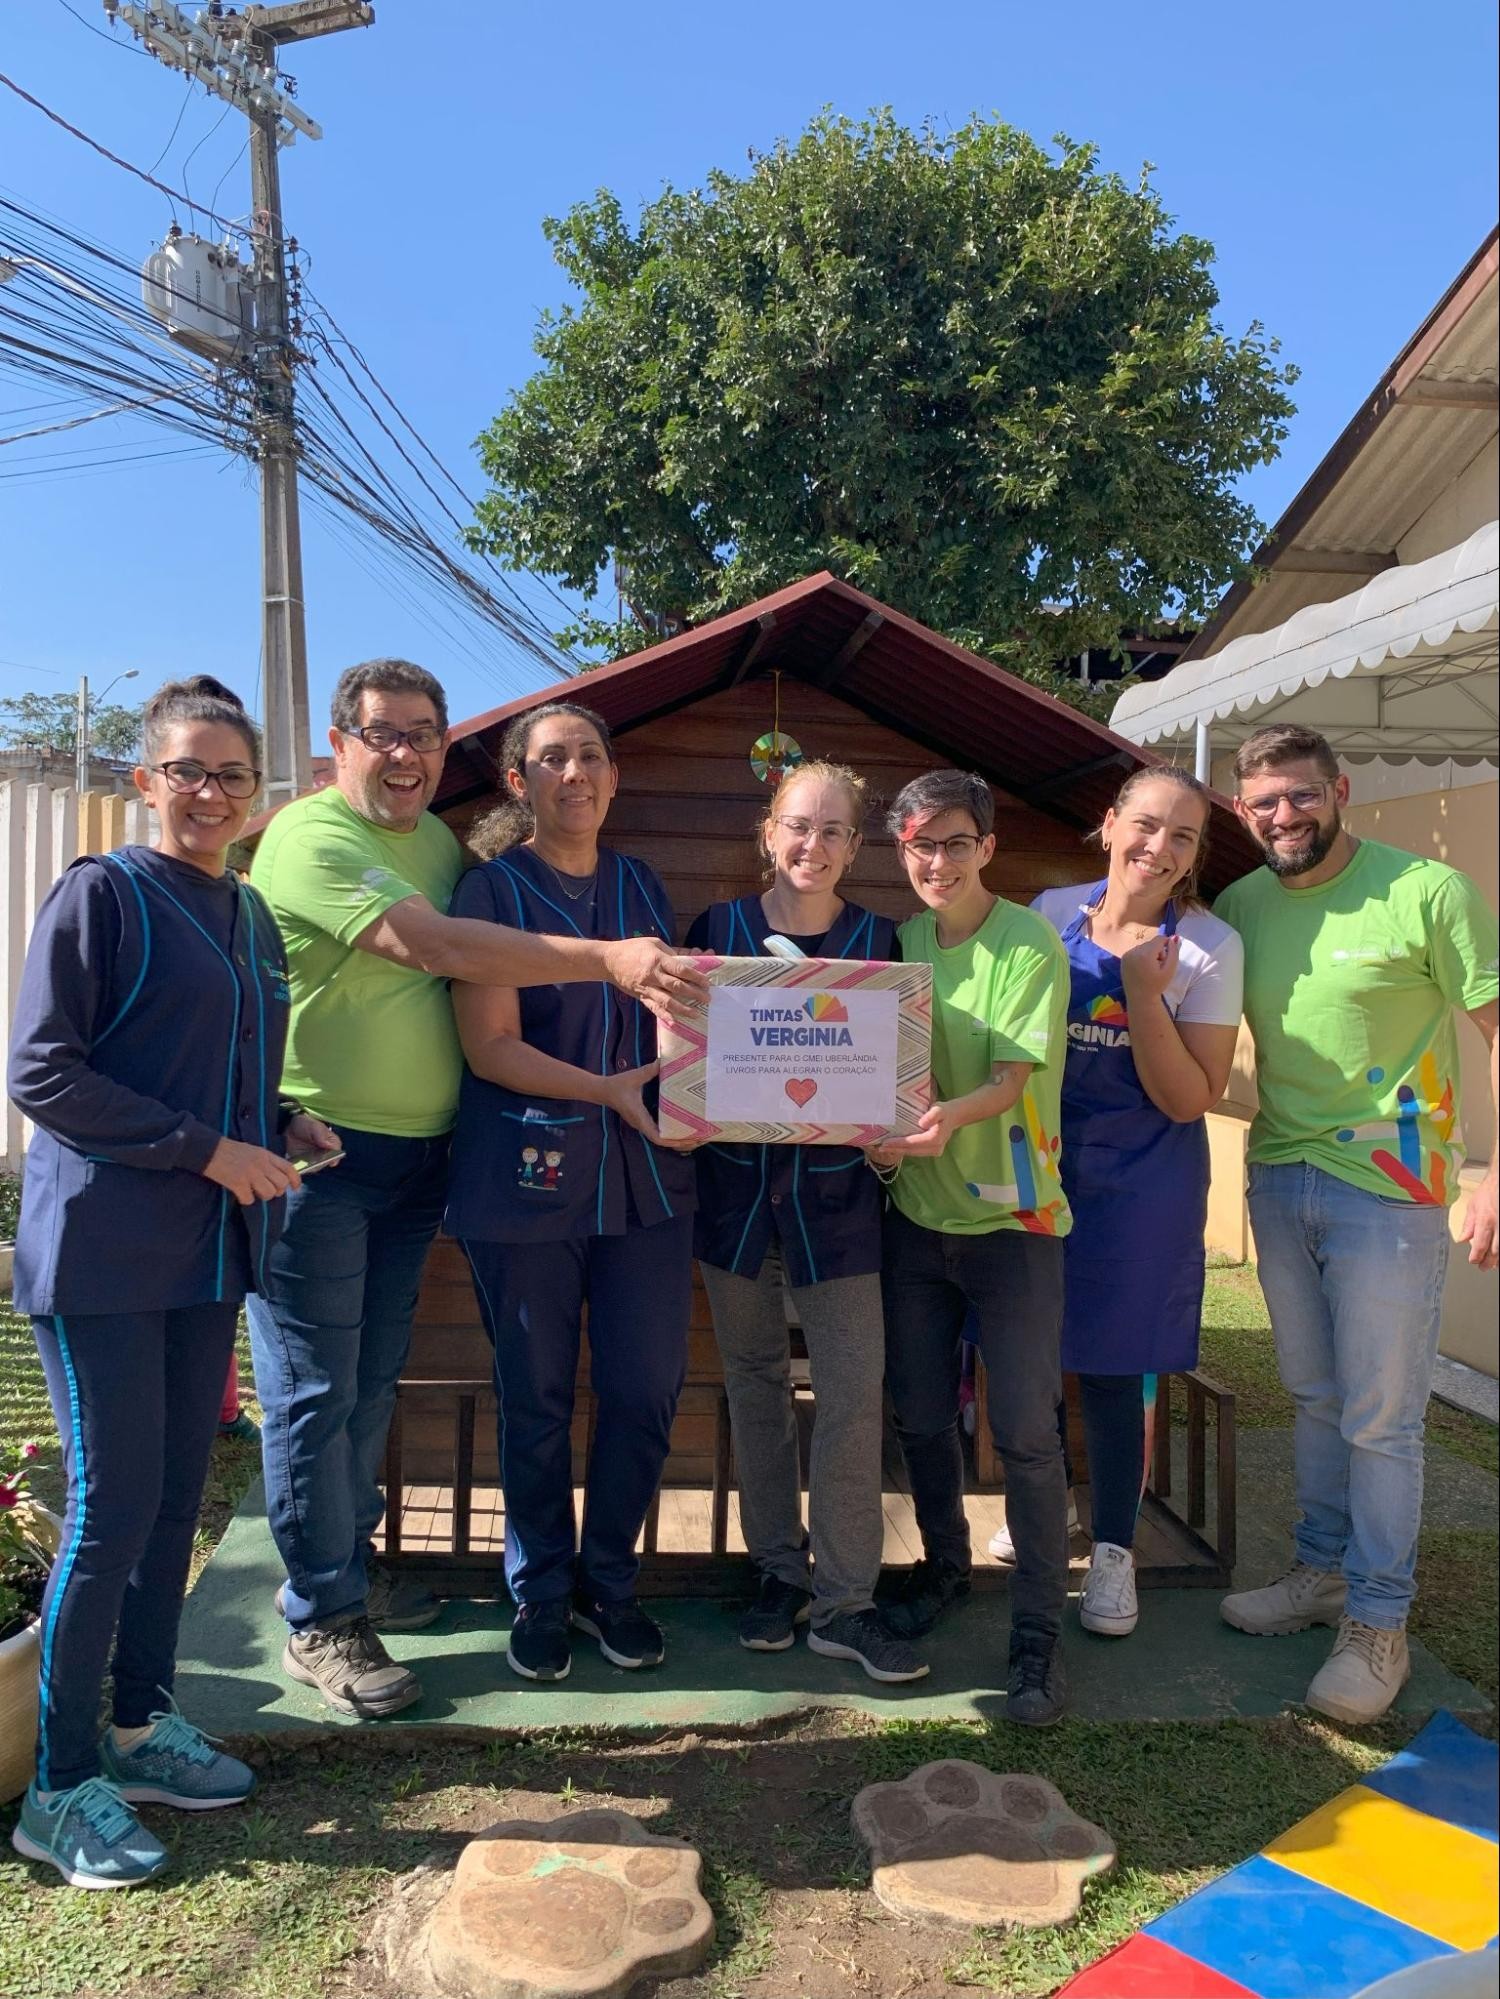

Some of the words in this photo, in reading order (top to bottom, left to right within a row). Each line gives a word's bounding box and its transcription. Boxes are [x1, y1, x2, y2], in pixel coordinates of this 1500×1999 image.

[750, 1009, 803, 1022] TINTAS
[750, 1027, 853, 1047] VERGINIA
[1066, 1022, 1131, 1047] GINIA
[723, 1054, 767, 1062] PRESENTE
[769, 1054, 792, 1062] PARA
[793, 1054, 801, 1062] O
[802, 1054, 823, 1062] CMEI
[825, 1053, 877, 1062] UBERLÂNDIA
[726, 1066, 757, 1074] LIVROS
[758, 1066, 781, 1074] PARA
[782, 1066, 822, 1075] ALEGRAR
[824, 1066, 831, 1075] O
